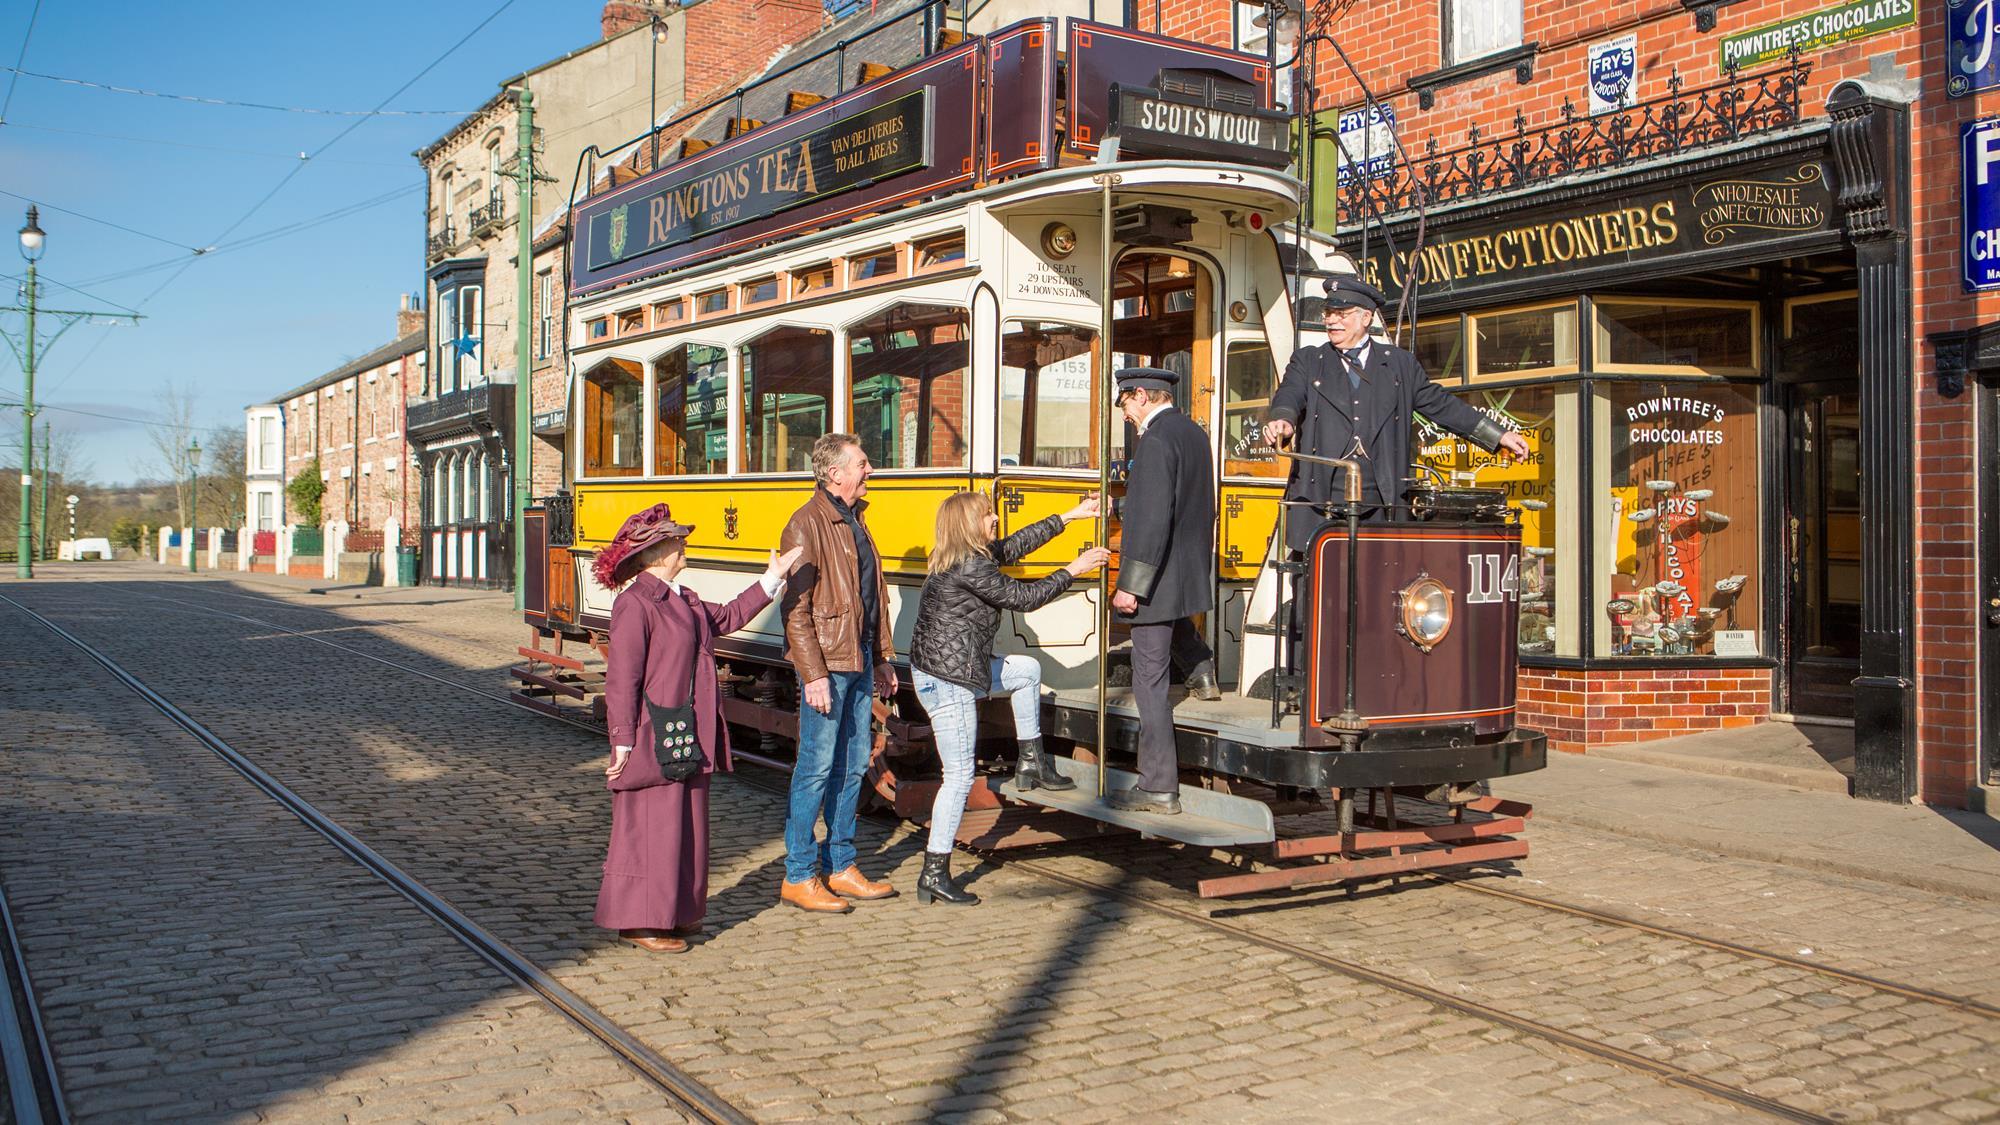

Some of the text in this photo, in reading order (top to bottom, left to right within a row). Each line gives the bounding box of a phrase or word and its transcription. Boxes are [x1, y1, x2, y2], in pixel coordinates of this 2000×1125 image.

[1724, 0, 1912, 61] ROWNTREE'S CHOCOLATES
[1824, 33, 1840, 42] THE
[1592, 51, 1633, 74] FRY'S
[1594, 74, 1631, 96] CHOCOLATE
[1141, 100, 1260, 146] SCOTSWOOD
[831, 115, 904, 155] VAN DELIVERIES
[835, 138, 899, 173] TO ALL AREAS
[648, 140, 819, 246] RINGTONS TEA
[1711, 185, 1800, 206] WHOLESALE
[726, 204, 741, 222] 1907
[1700, 202, 1820, 228] CONFECTIONERY
[1390, 201, 1679, 289] CONFECTIONERS
[1037, 263, 1078, 274] TO SEAT
[1027, 273, 1084, 287] 29 UPSTAIRS
[1019, 284, 1091, 299] 24 DOWNSTAIRS
[1627, 397, 1725, 423] ROWNTREE'S
[1234, 429, 1260, 456] FRY'S
[1630, 428, 1723, 444] CHOCOLATES
[1421, 444, 1452, 456] MAKERS
[1457, 443, 1467, 453] TO
[1466, 453, 1498, 468] Used
[1501, 481, 1517, 496] Of
[1521, 480, 1547, 496] Our
[1657, 497, 1697, 518] FRY'S
[1466, 554, 1520, 604] 114
